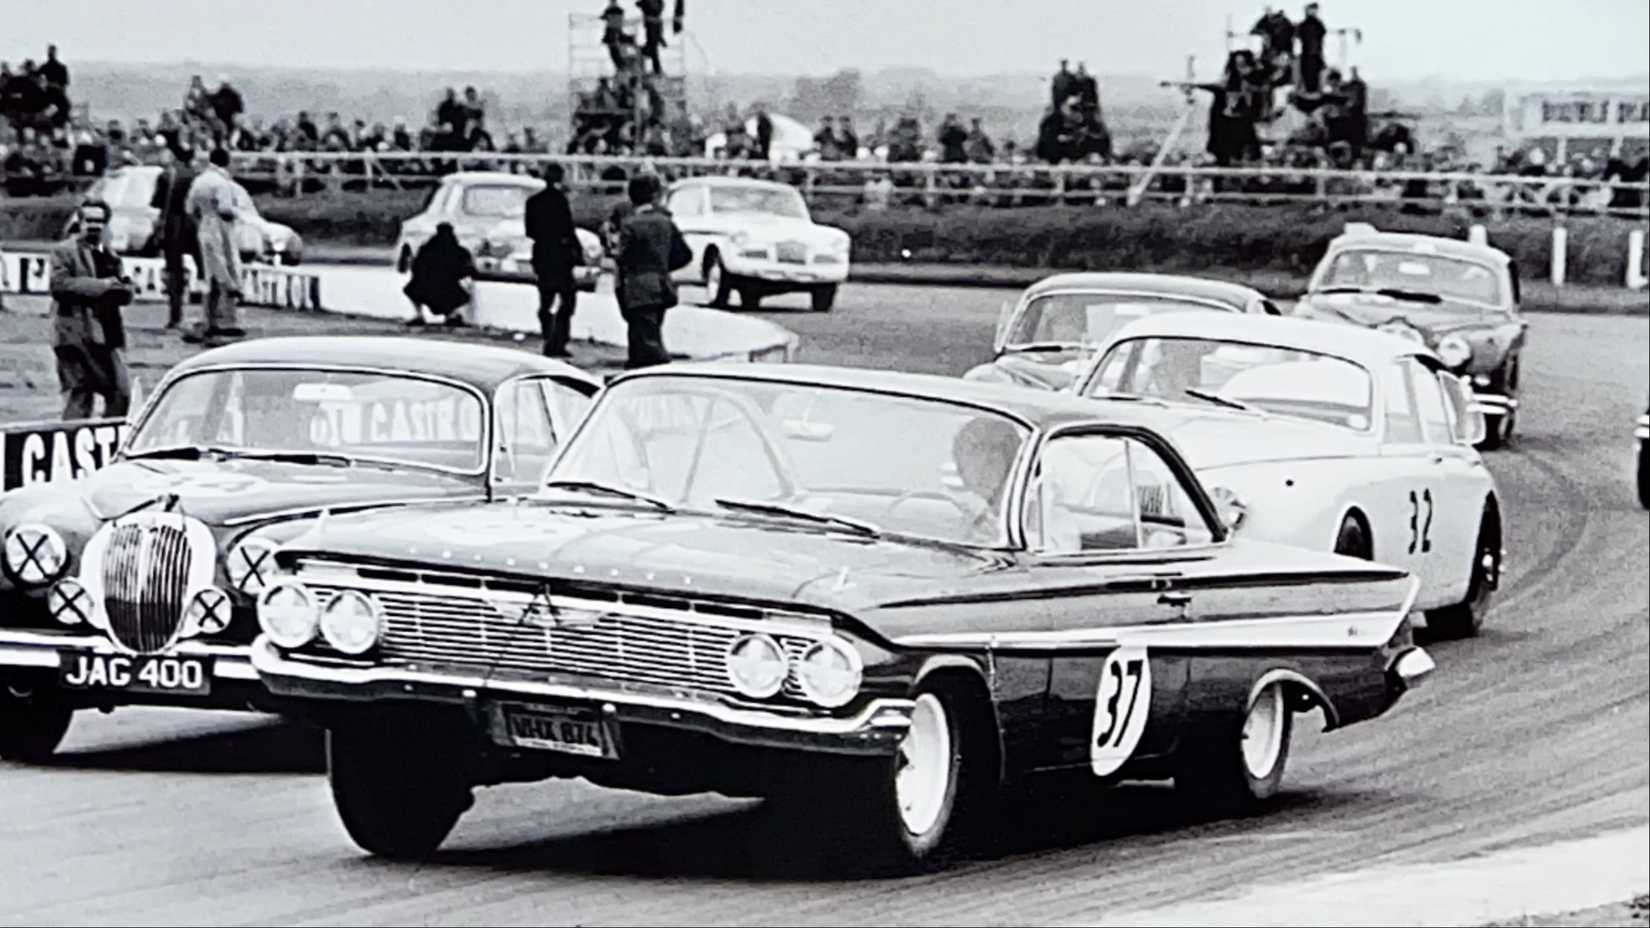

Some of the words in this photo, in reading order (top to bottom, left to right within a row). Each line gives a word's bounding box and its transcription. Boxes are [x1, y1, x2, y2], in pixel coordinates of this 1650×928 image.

[1408, 488, 1433, 555] 32
[65, 656, 131, 686] JAG
[138, 659, 203, 689] 400
[1097, 660, 1143, 748] 37
